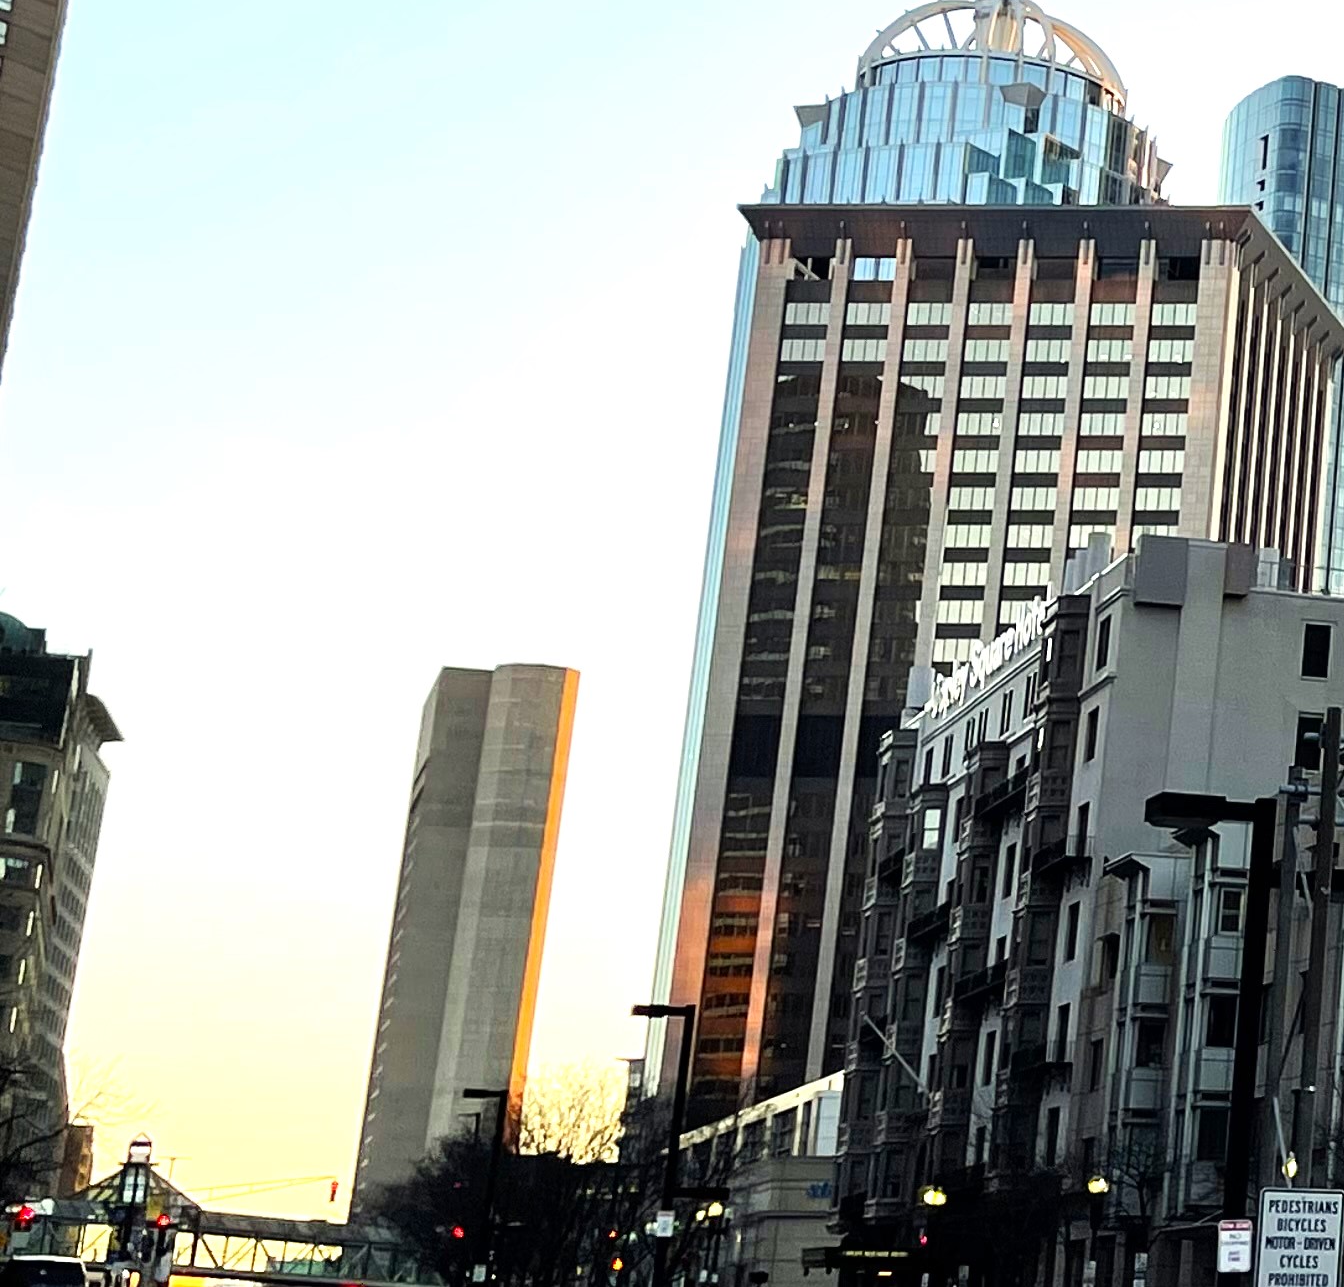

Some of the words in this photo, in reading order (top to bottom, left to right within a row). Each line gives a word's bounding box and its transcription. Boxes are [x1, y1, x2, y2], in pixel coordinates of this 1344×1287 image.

[969, 627, 1016, 689] Square
[1268, 1199, 1339, 1215] PEDESTRIANS
[1276, 1218, 1327, 1233] BICYCLES
[1279, 1255, 1319, 1269] CYCLES
[1267, 1272, 1329, 1287] PROHIBITED
